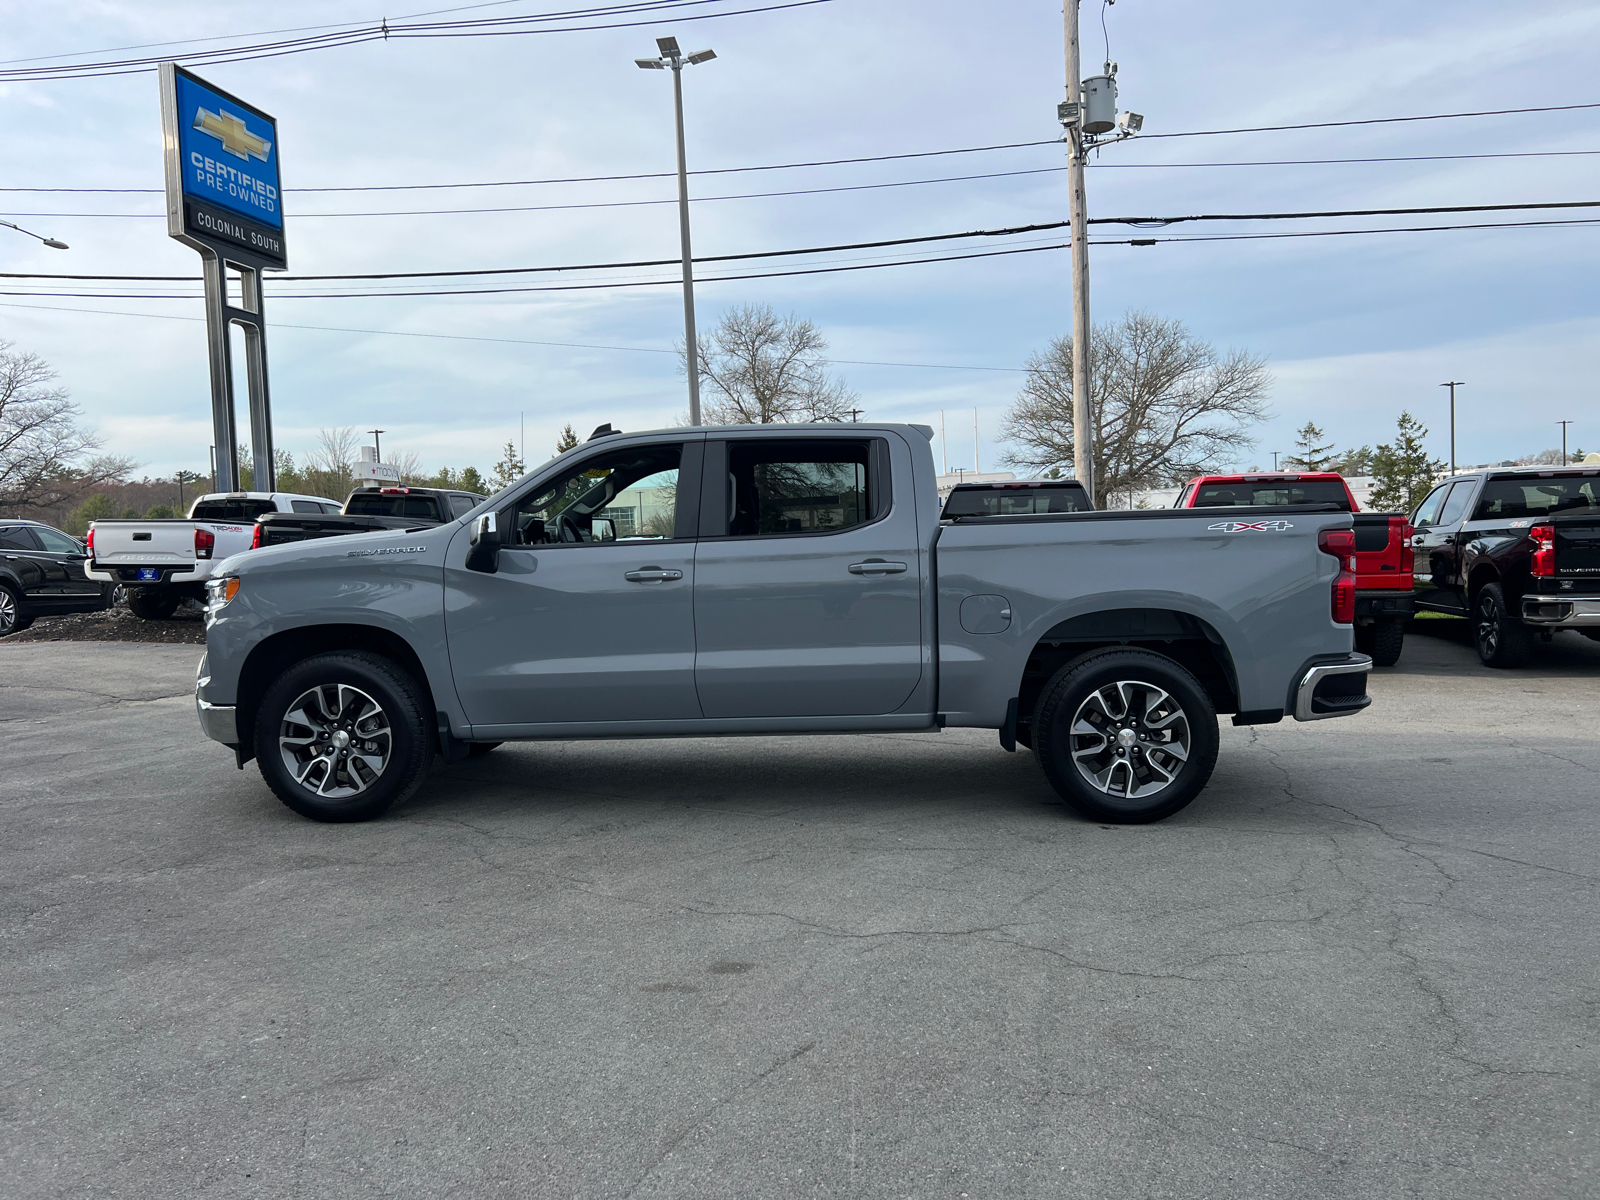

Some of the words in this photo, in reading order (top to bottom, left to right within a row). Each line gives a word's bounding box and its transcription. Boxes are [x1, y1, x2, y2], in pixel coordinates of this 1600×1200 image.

[191, 151, 277, 200] CERTIFIED
[196, 169, 275, 212] PRE-OWNED
[197, 212, 246, 241] COLONIAL
[251, 232, 280, 252] SOUTH
[347, 546, 427, 557] SILVERADO
